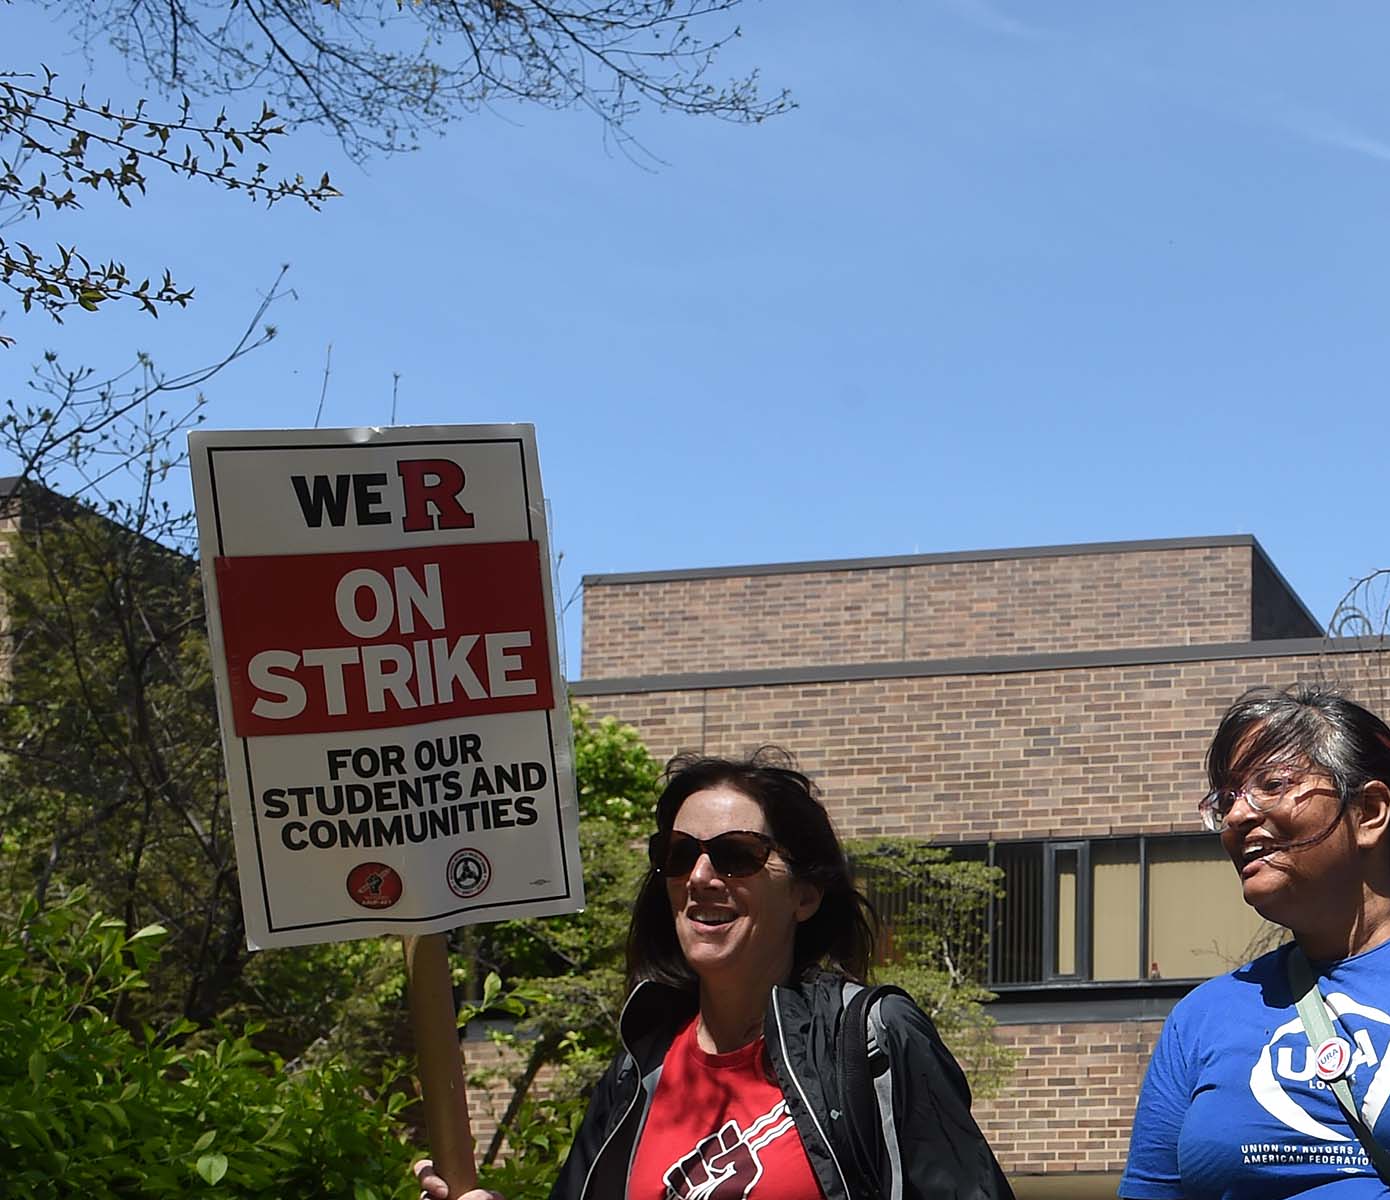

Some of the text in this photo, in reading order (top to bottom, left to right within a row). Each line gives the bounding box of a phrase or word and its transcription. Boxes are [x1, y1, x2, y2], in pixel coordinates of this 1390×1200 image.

[291, 458, 475, 532] WE R
[334, 563, 446, 639] ON
[247, 631, 537, 720] STRIKE
[327, 734, 482, 781] FOR OUR
[263, 762, 547, 819] STUDENTS AND
[281, 797, 538, 851] COMMUNITIES
[1277, 1029, 1379, 1081] UA
[1320, 1047, 1339, 1065] URA
[1241, 1144, 1279, 1153] UNION
[1284, 1145, 1297, 1153] OF
[1302, 1144, 1353, 1154] RUTGERS
[1244, 1155, 1371, 1166] AMERICAN FEDERATIO
